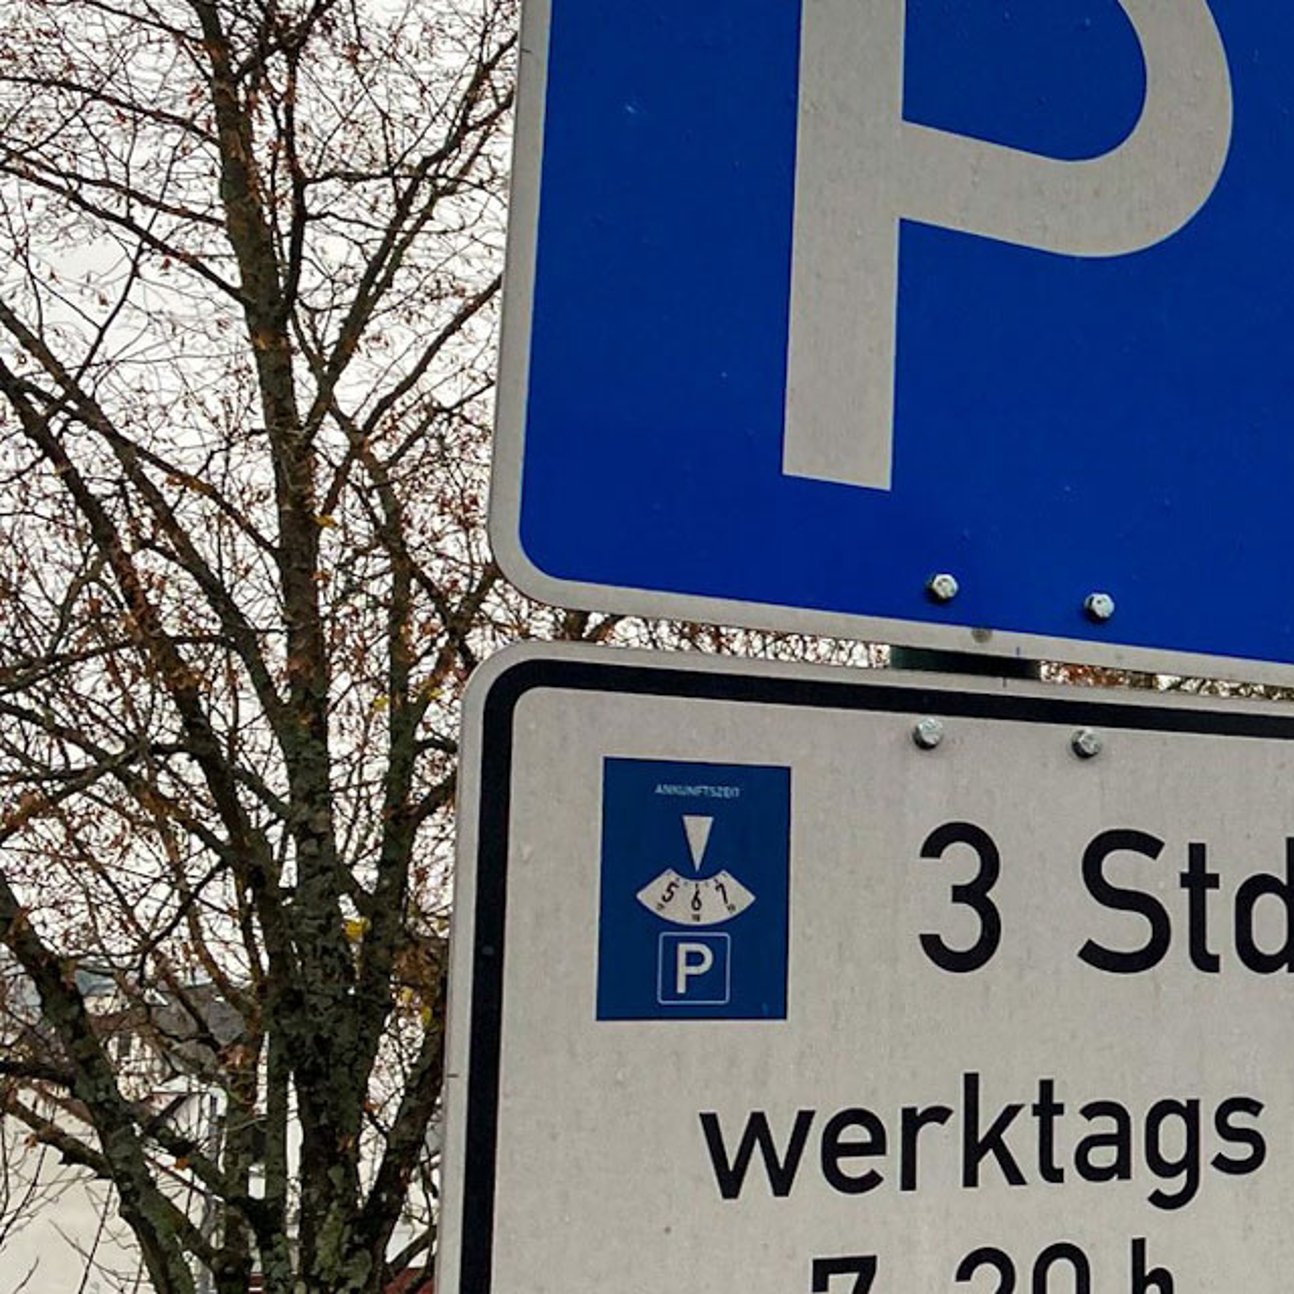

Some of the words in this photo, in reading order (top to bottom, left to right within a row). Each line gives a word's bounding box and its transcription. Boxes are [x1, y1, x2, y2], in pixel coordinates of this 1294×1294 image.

[783, 0, 1232, 490] P
[662, 881, 679, 902] 5
[691, 889, 702, 911] 6
[715, 883, 728, 904] 7
[919, 821, 1002, 974] 3
[676, 943, 713, 994] P
[699, 1073, 1267, 1211] werktags
